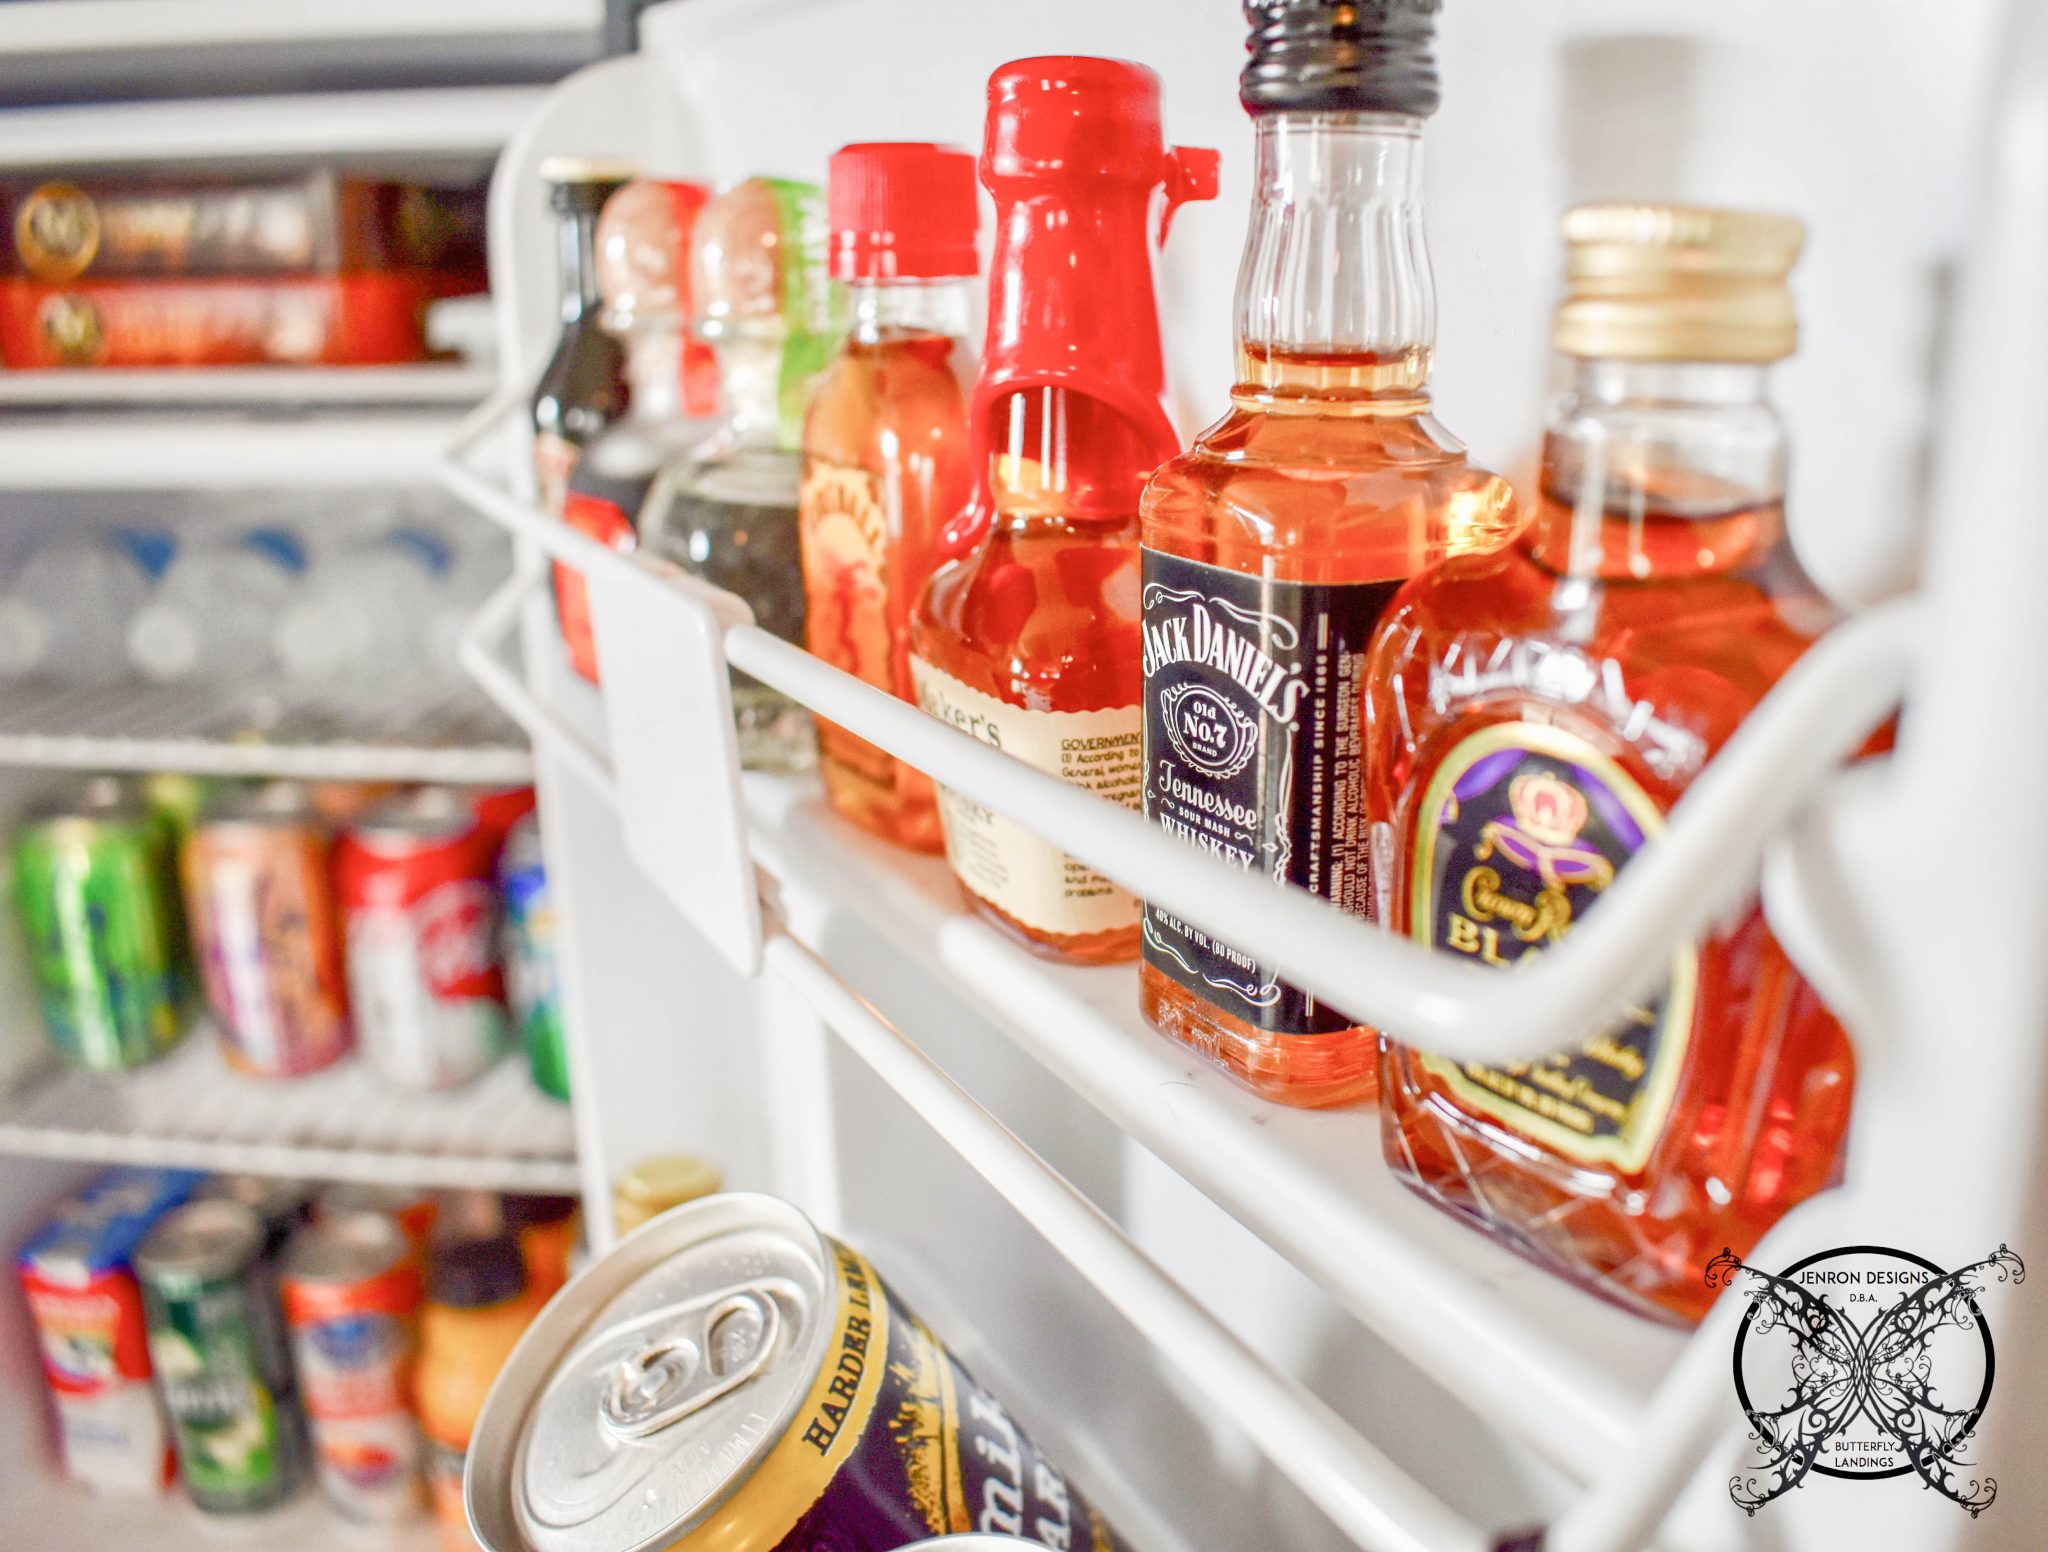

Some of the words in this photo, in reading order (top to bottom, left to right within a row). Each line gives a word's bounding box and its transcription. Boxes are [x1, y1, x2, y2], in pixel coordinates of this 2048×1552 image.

[1142, 617, 1192, 677] JACK
[1193, 604, 1311, 724] DANIEL'S
[1315, 654, 1329, 693] 1866
[1193, 701, 1217, 720] Old
[1313, 698, 1326, 749] SINCE
[1336, 681, 1351, 732] SURGEON
[1183, 712, 1228, 748] No.7
[1335, 736, 1349, 757] THE
[1061, 752, 1072, 763] (1)
[1077, 750, 1125, 763] According
[1129, 748, 1140, 757] to
[1192, 742, 1218, 757] BRAND
[1335, 760, 1348, 776] TO
[1062, 766, 1105, 777] General
[1347, 758, 1362, 813] ALCOHOLIC
[1159, 759, 1258, 830] Tennessee
[1332, 780, 1348, 839] ACCORDING
[1178, 806, 1202, 825] SOUR
[1204, 817, 1232, 838] MASH
[1309, 754, 1324, 893] CRAFTSMANSHIP
[1345, 816, 1358, 848] DRINK
[1159, 811, 1256, 874] WHISKEY
[1345, 849, 1357, 872] NOT
[1357, 842, 1369, 861] THE
[1357, 863, 1368, 876] OF
[1343, 873, 1356, 912] SHOULD
[1155, 908, 1169, 926] 40%
[1169, 920, 1184, 935] ALC.
[1184, 924, 1195, 940] BY
[1194, 930, 1211, 950] VOL.
[1212, 939, 1226, 957] (80
[1226, 948, 1257, 974] PROOF)
[802, 1315, 872, 1457] HARDER
